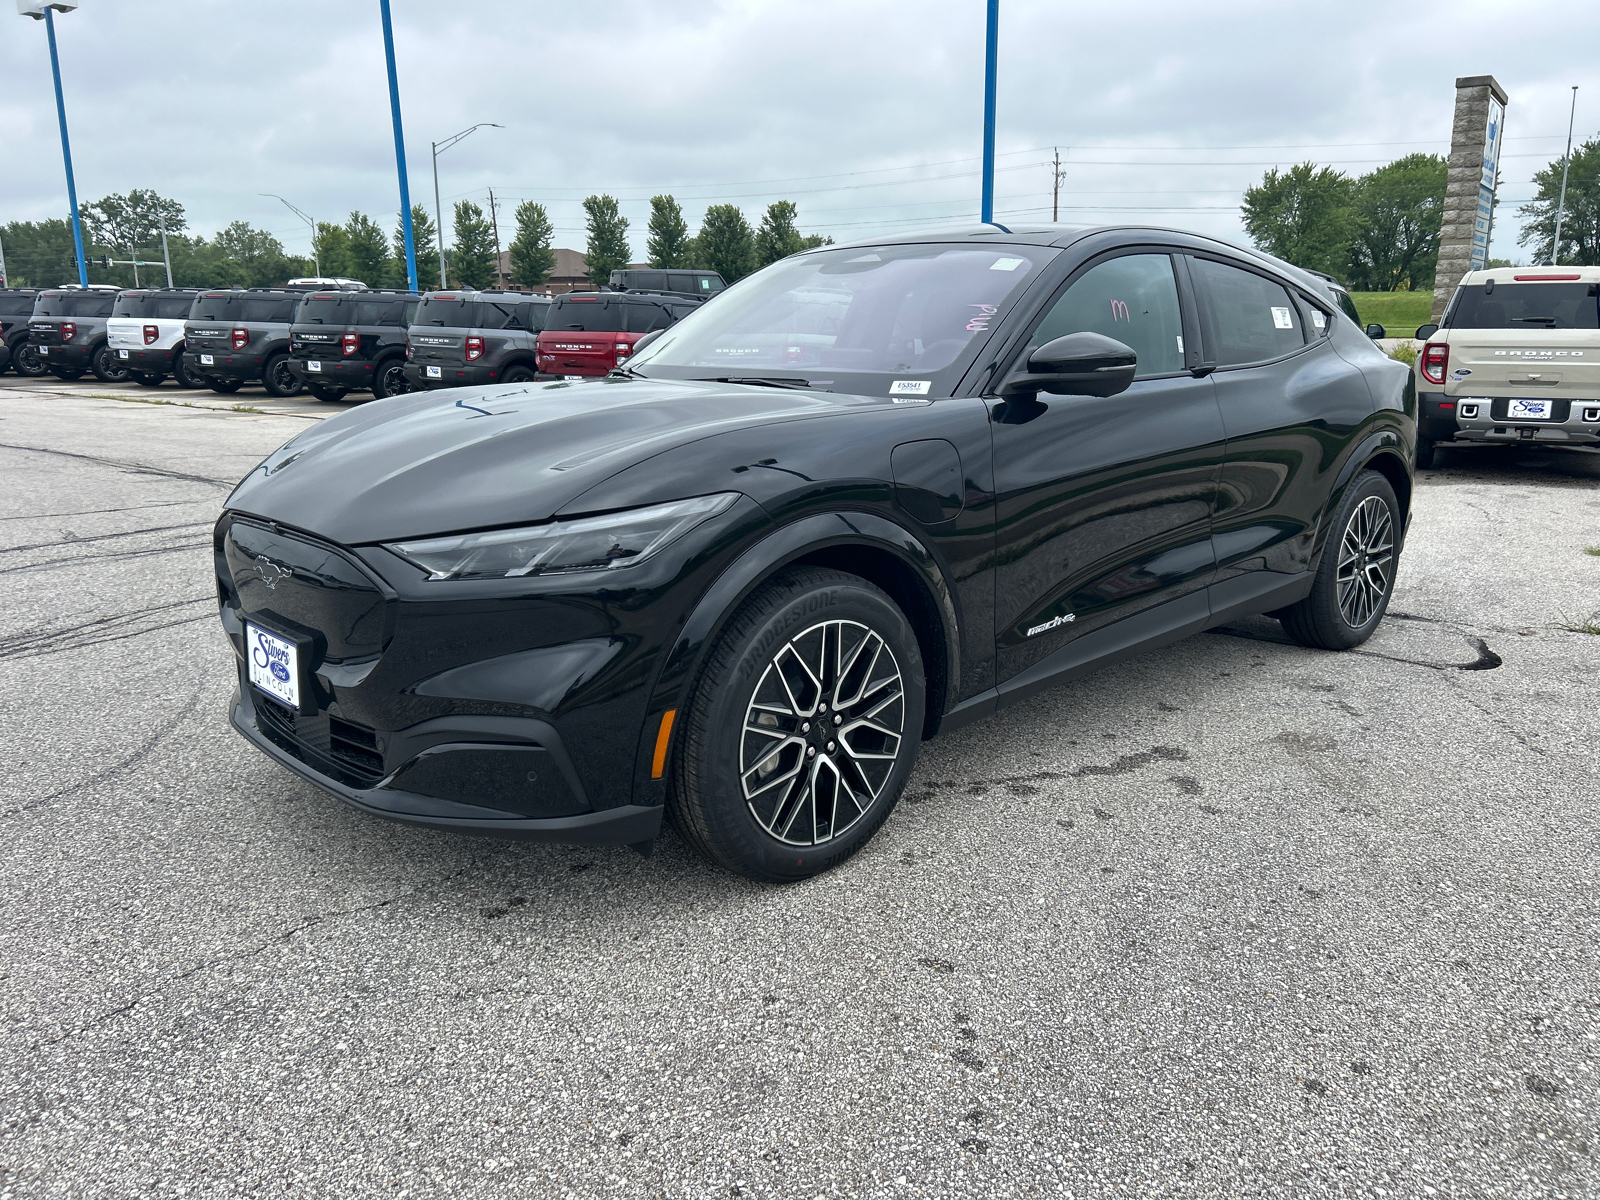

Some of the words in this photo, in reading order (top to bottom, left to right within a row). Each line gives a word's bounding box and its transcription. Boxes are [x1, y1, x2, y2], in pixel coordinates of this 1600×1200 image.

[737, 589, 838, 679] BRIDGESTONE
[253, 632, 290, 668] Stivers
[258, 671, 294, 698] LINCOLN
[272, 662, 288, 681] Ford
